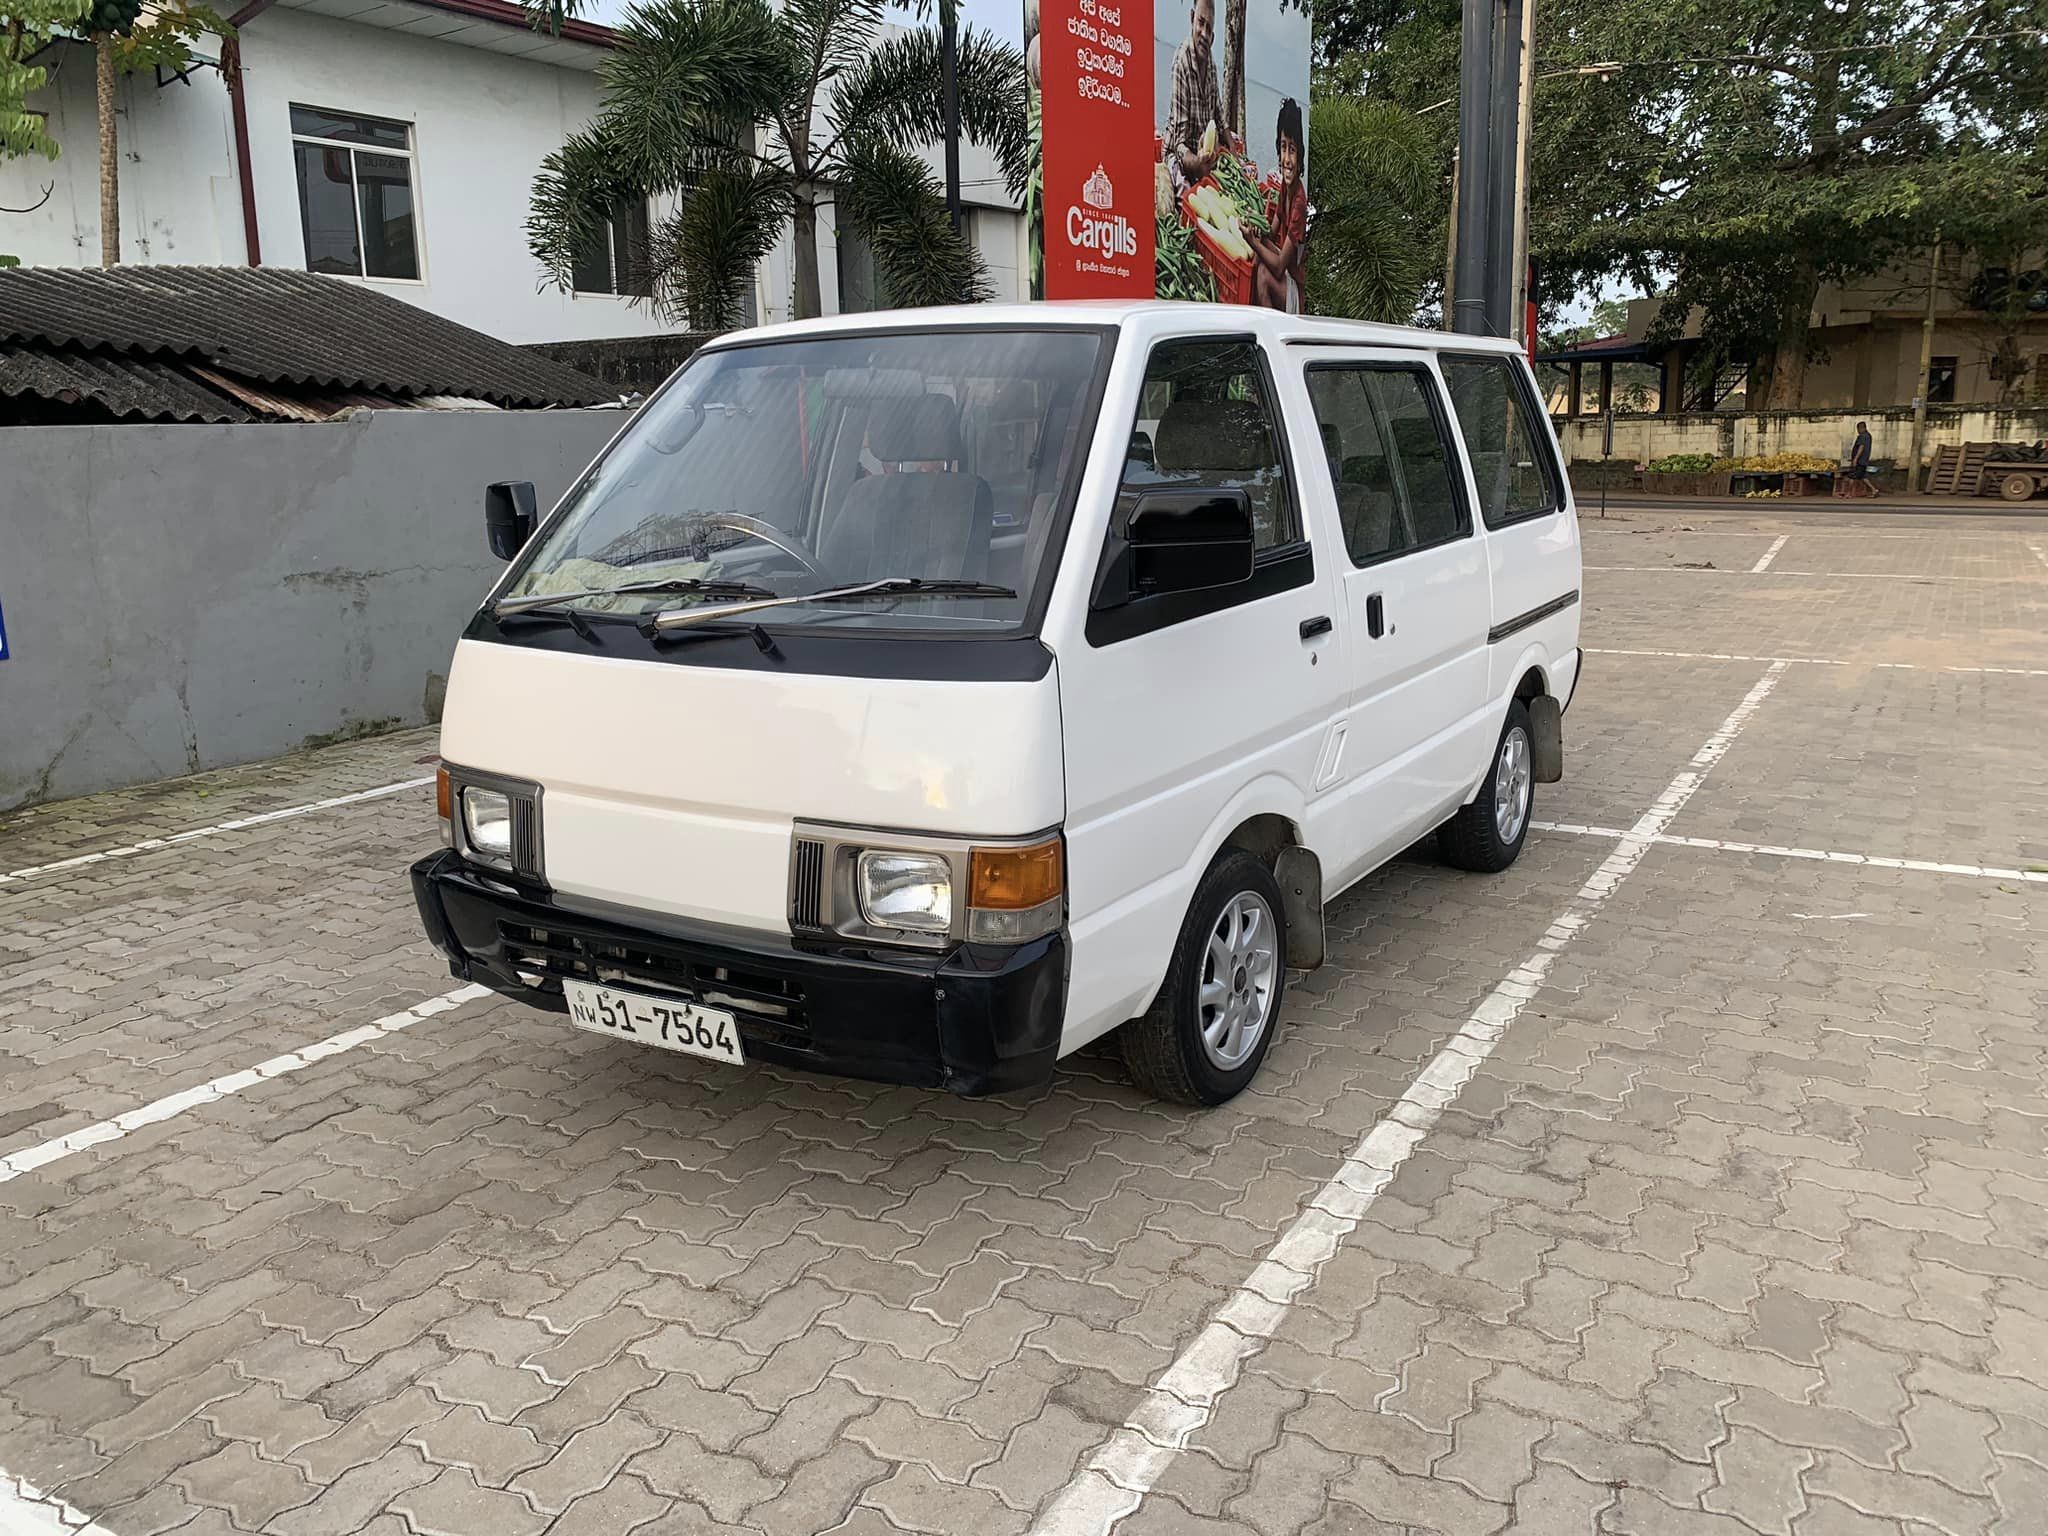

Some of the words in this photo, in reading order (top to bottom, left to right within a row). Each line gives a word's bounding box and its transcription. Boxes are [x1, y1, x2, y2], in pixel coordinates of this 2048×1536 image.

[1067, 16, 1098, 43] ජාතික
[1077, 48, 1124, 78] ඉටුකරමින්
[1066, 205, 1137, 259] Cargills
[573, 1003, 597, 1025] NW
[597, 994, 735, 1056] 51-7564
